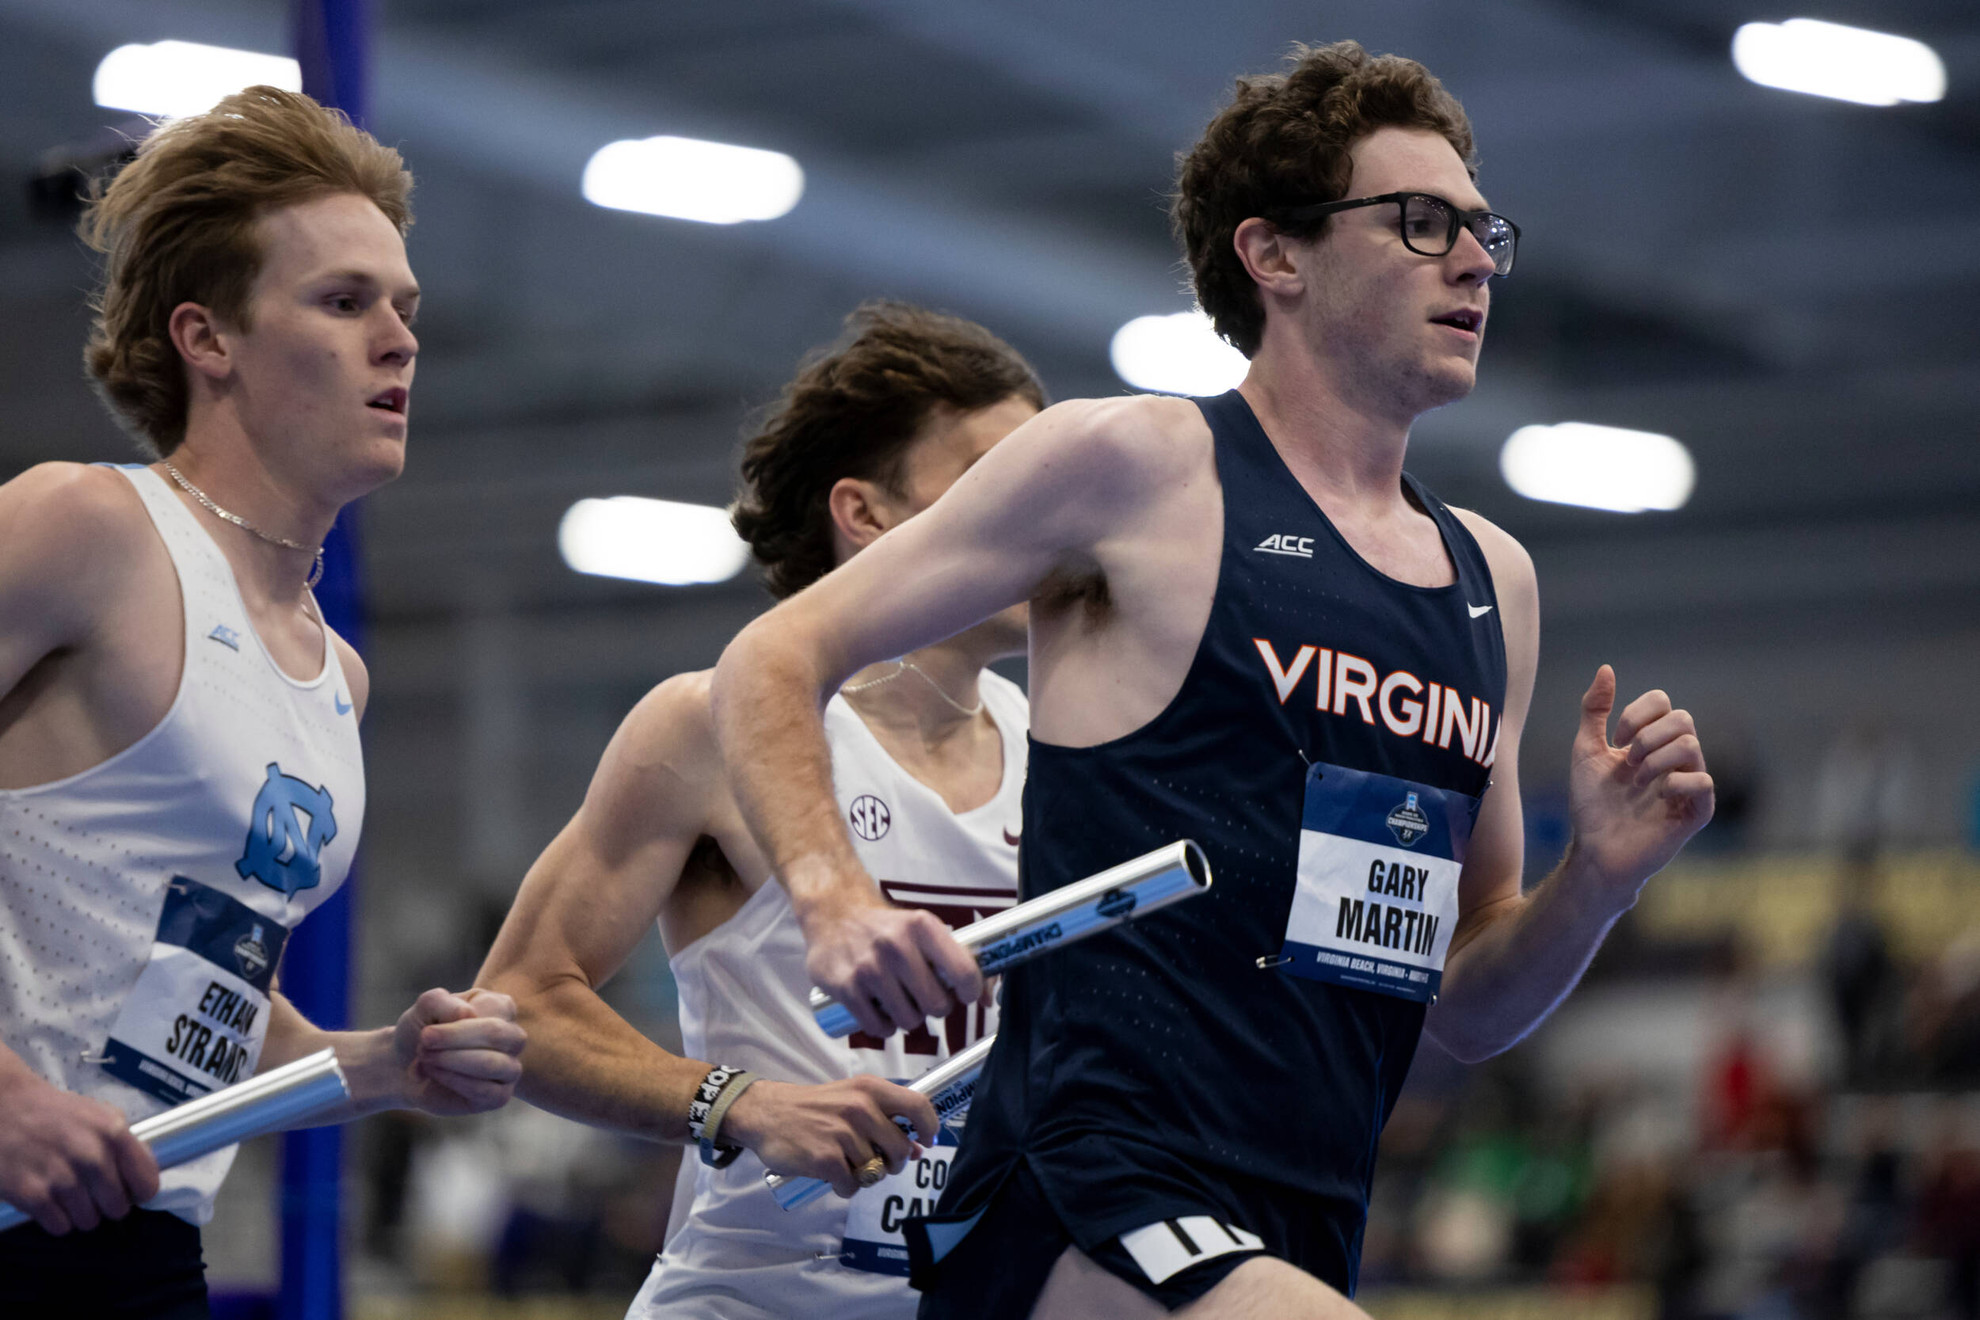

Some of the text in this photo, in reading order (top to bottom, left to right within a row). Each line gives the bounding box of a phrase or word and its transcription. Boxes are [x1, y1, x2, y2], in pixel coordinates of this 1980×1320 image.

[1253, 533, 1315, 558] ACC
[850, 795, 891, 841] SEC
[1368, 859, 1430, 902] GARY
[1335, 896, 1440, 957] MARTIN
[197, 981, 259, 1037] ETHAN
[916, 1157, 947, 1190] CO
